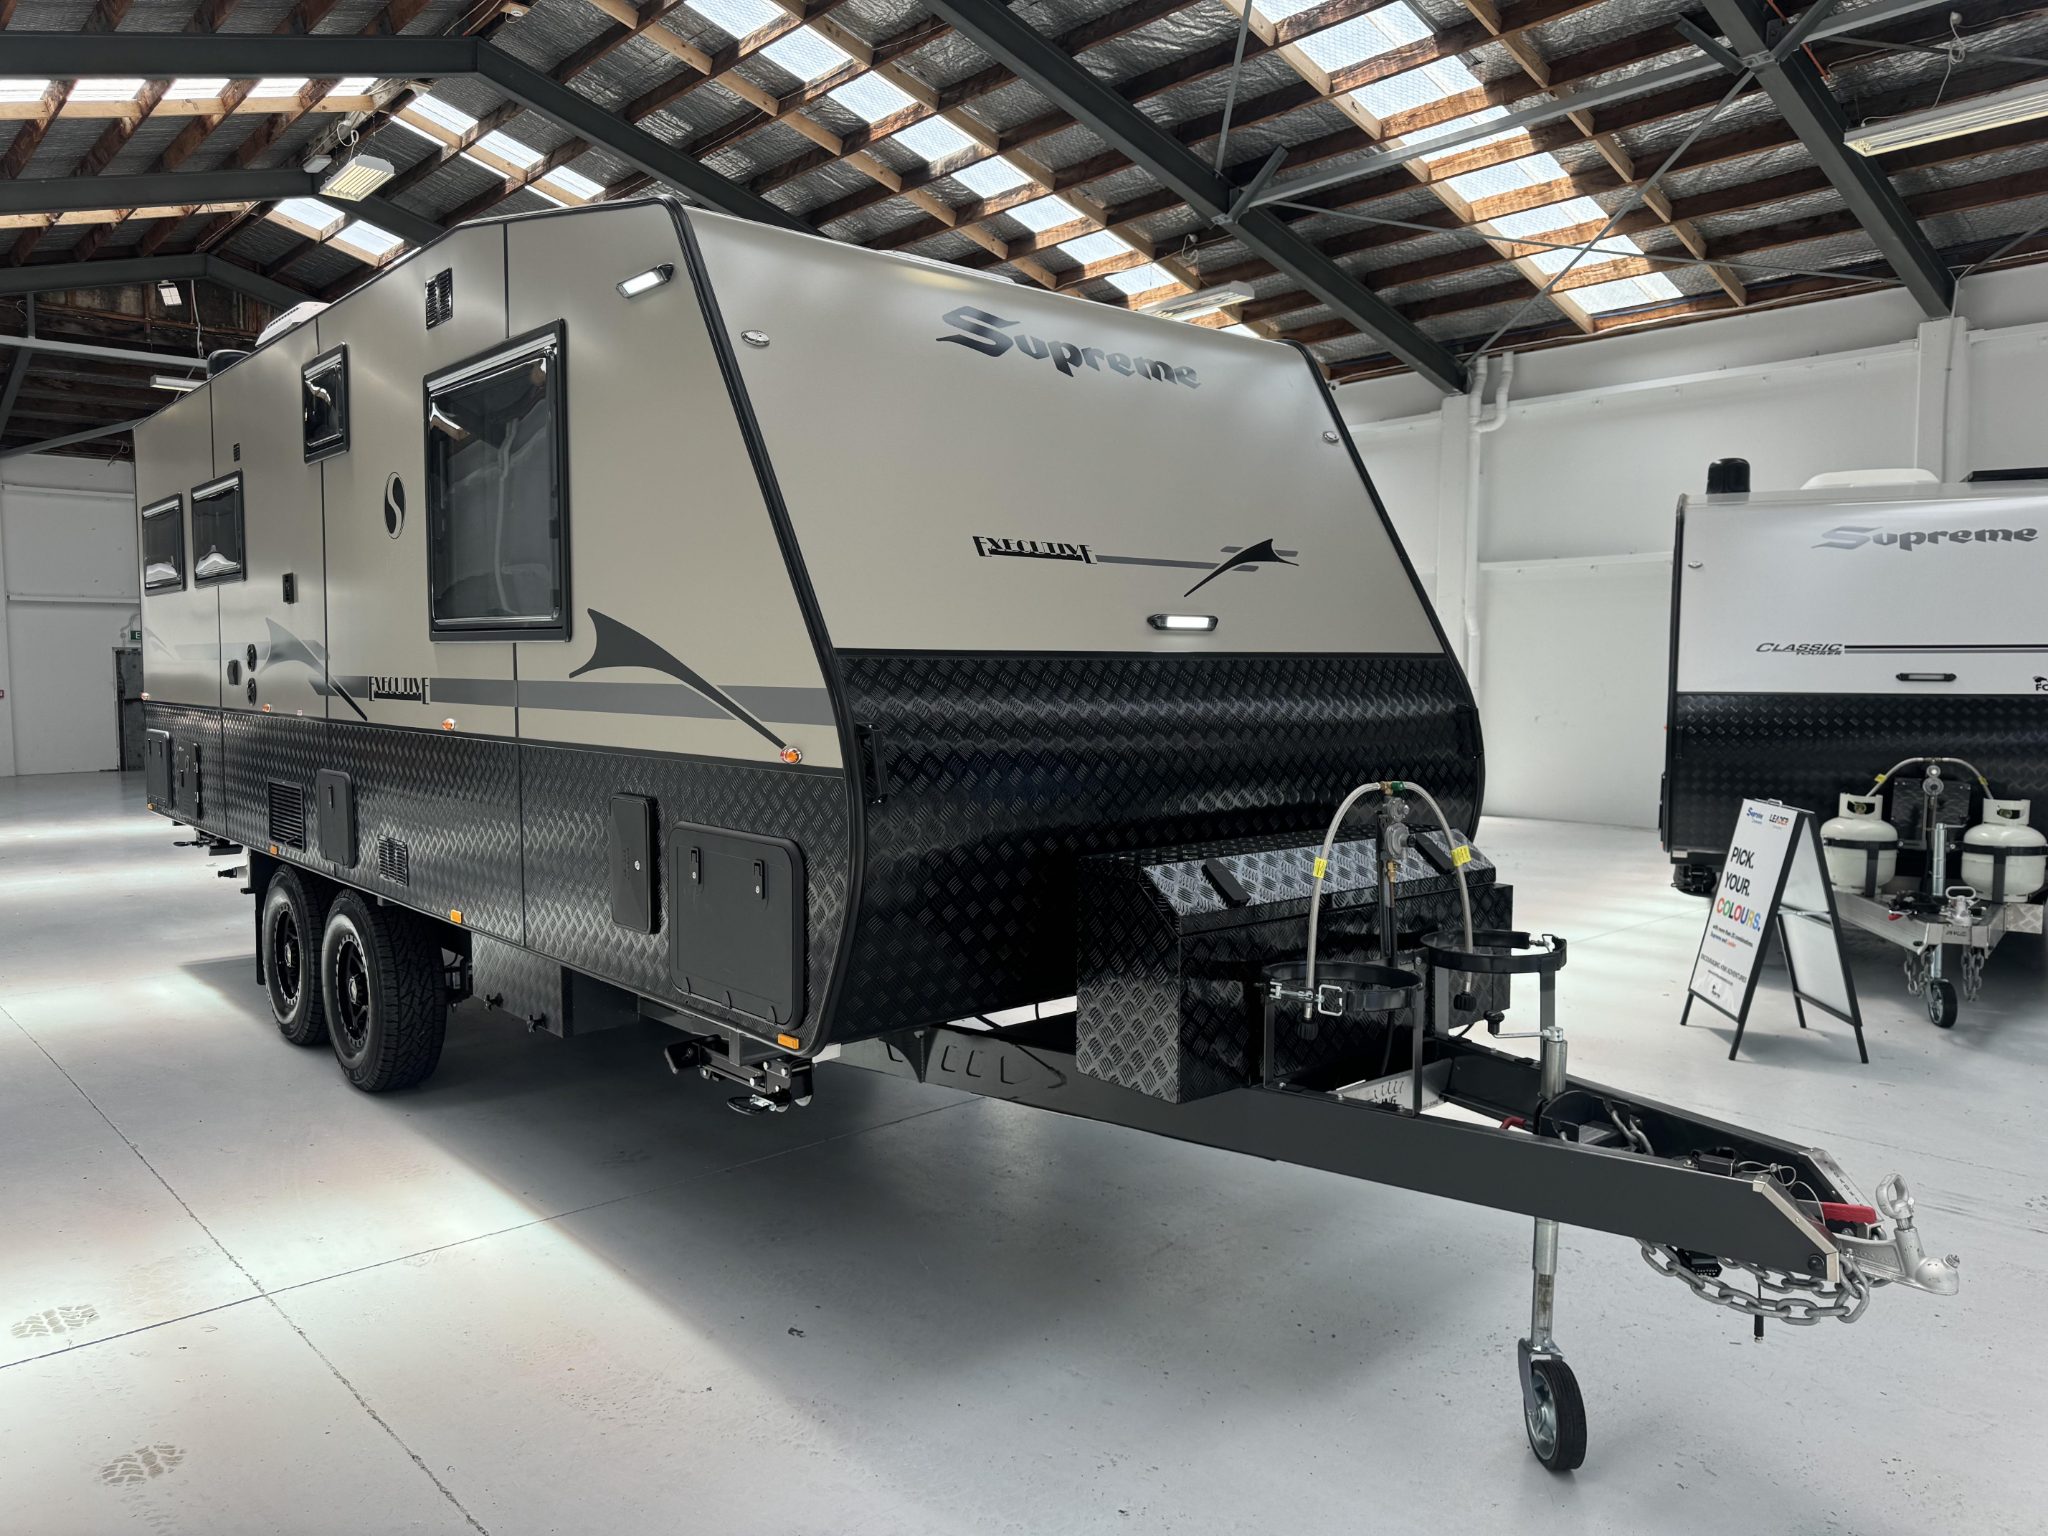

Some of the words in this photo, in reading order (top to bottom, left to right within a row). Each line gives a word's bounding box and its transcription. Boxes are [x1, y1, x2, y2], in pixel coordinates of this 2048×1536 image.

[936, 305, 1202, 390] Supreme
[972, 535, 1098, 565] EXECUTIVE
[1811, 525, 2039, 552] Supreme
[1756, 642, 1843, 653] CLASSIC
[368, 675, 430, 705] EXECUTIVE
[1730, 846, 1755, 870] PICK.
[1725, 872, 1750, 897] YOUR.
[1716, 897, 1761, 932] COLOURS.
